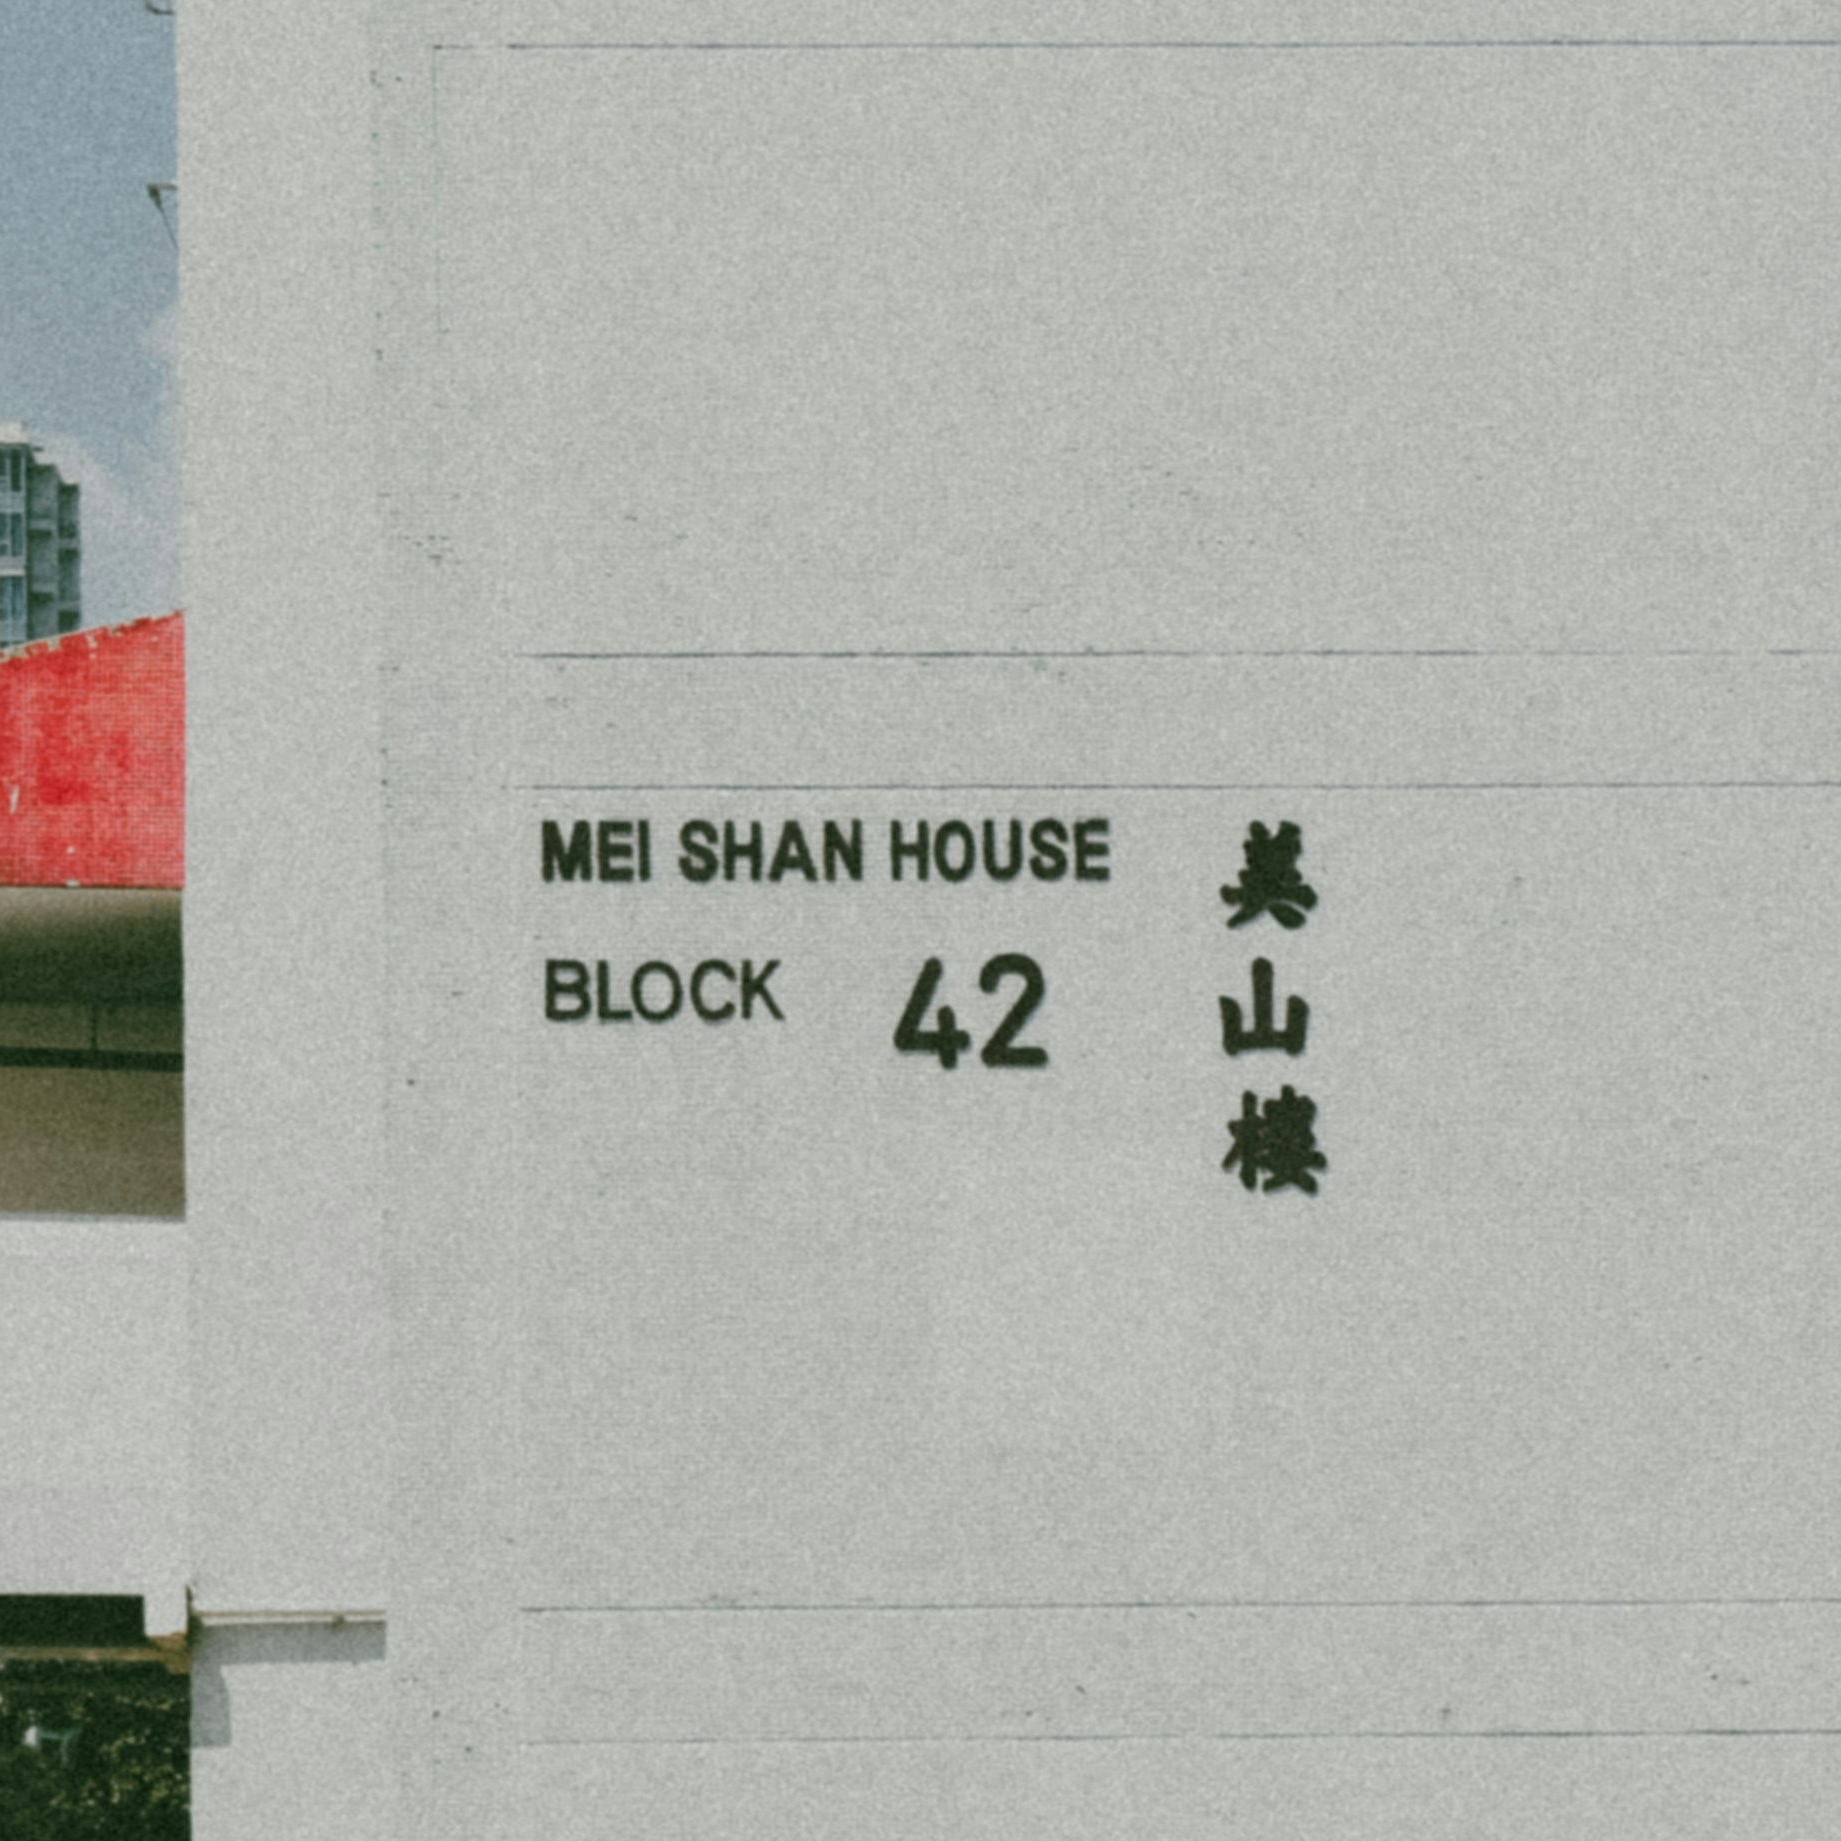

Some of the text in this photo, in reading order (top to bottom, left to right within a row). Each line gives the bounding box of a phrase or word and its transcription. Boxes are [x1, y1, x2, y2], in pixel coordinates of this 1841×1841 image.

[541, 818, 1111, 884] MEI SHAN HOUSE
[544, 952, 1049, 1070] BLOCK 42
[1219, 820, 1328, 1197] 美山樓
